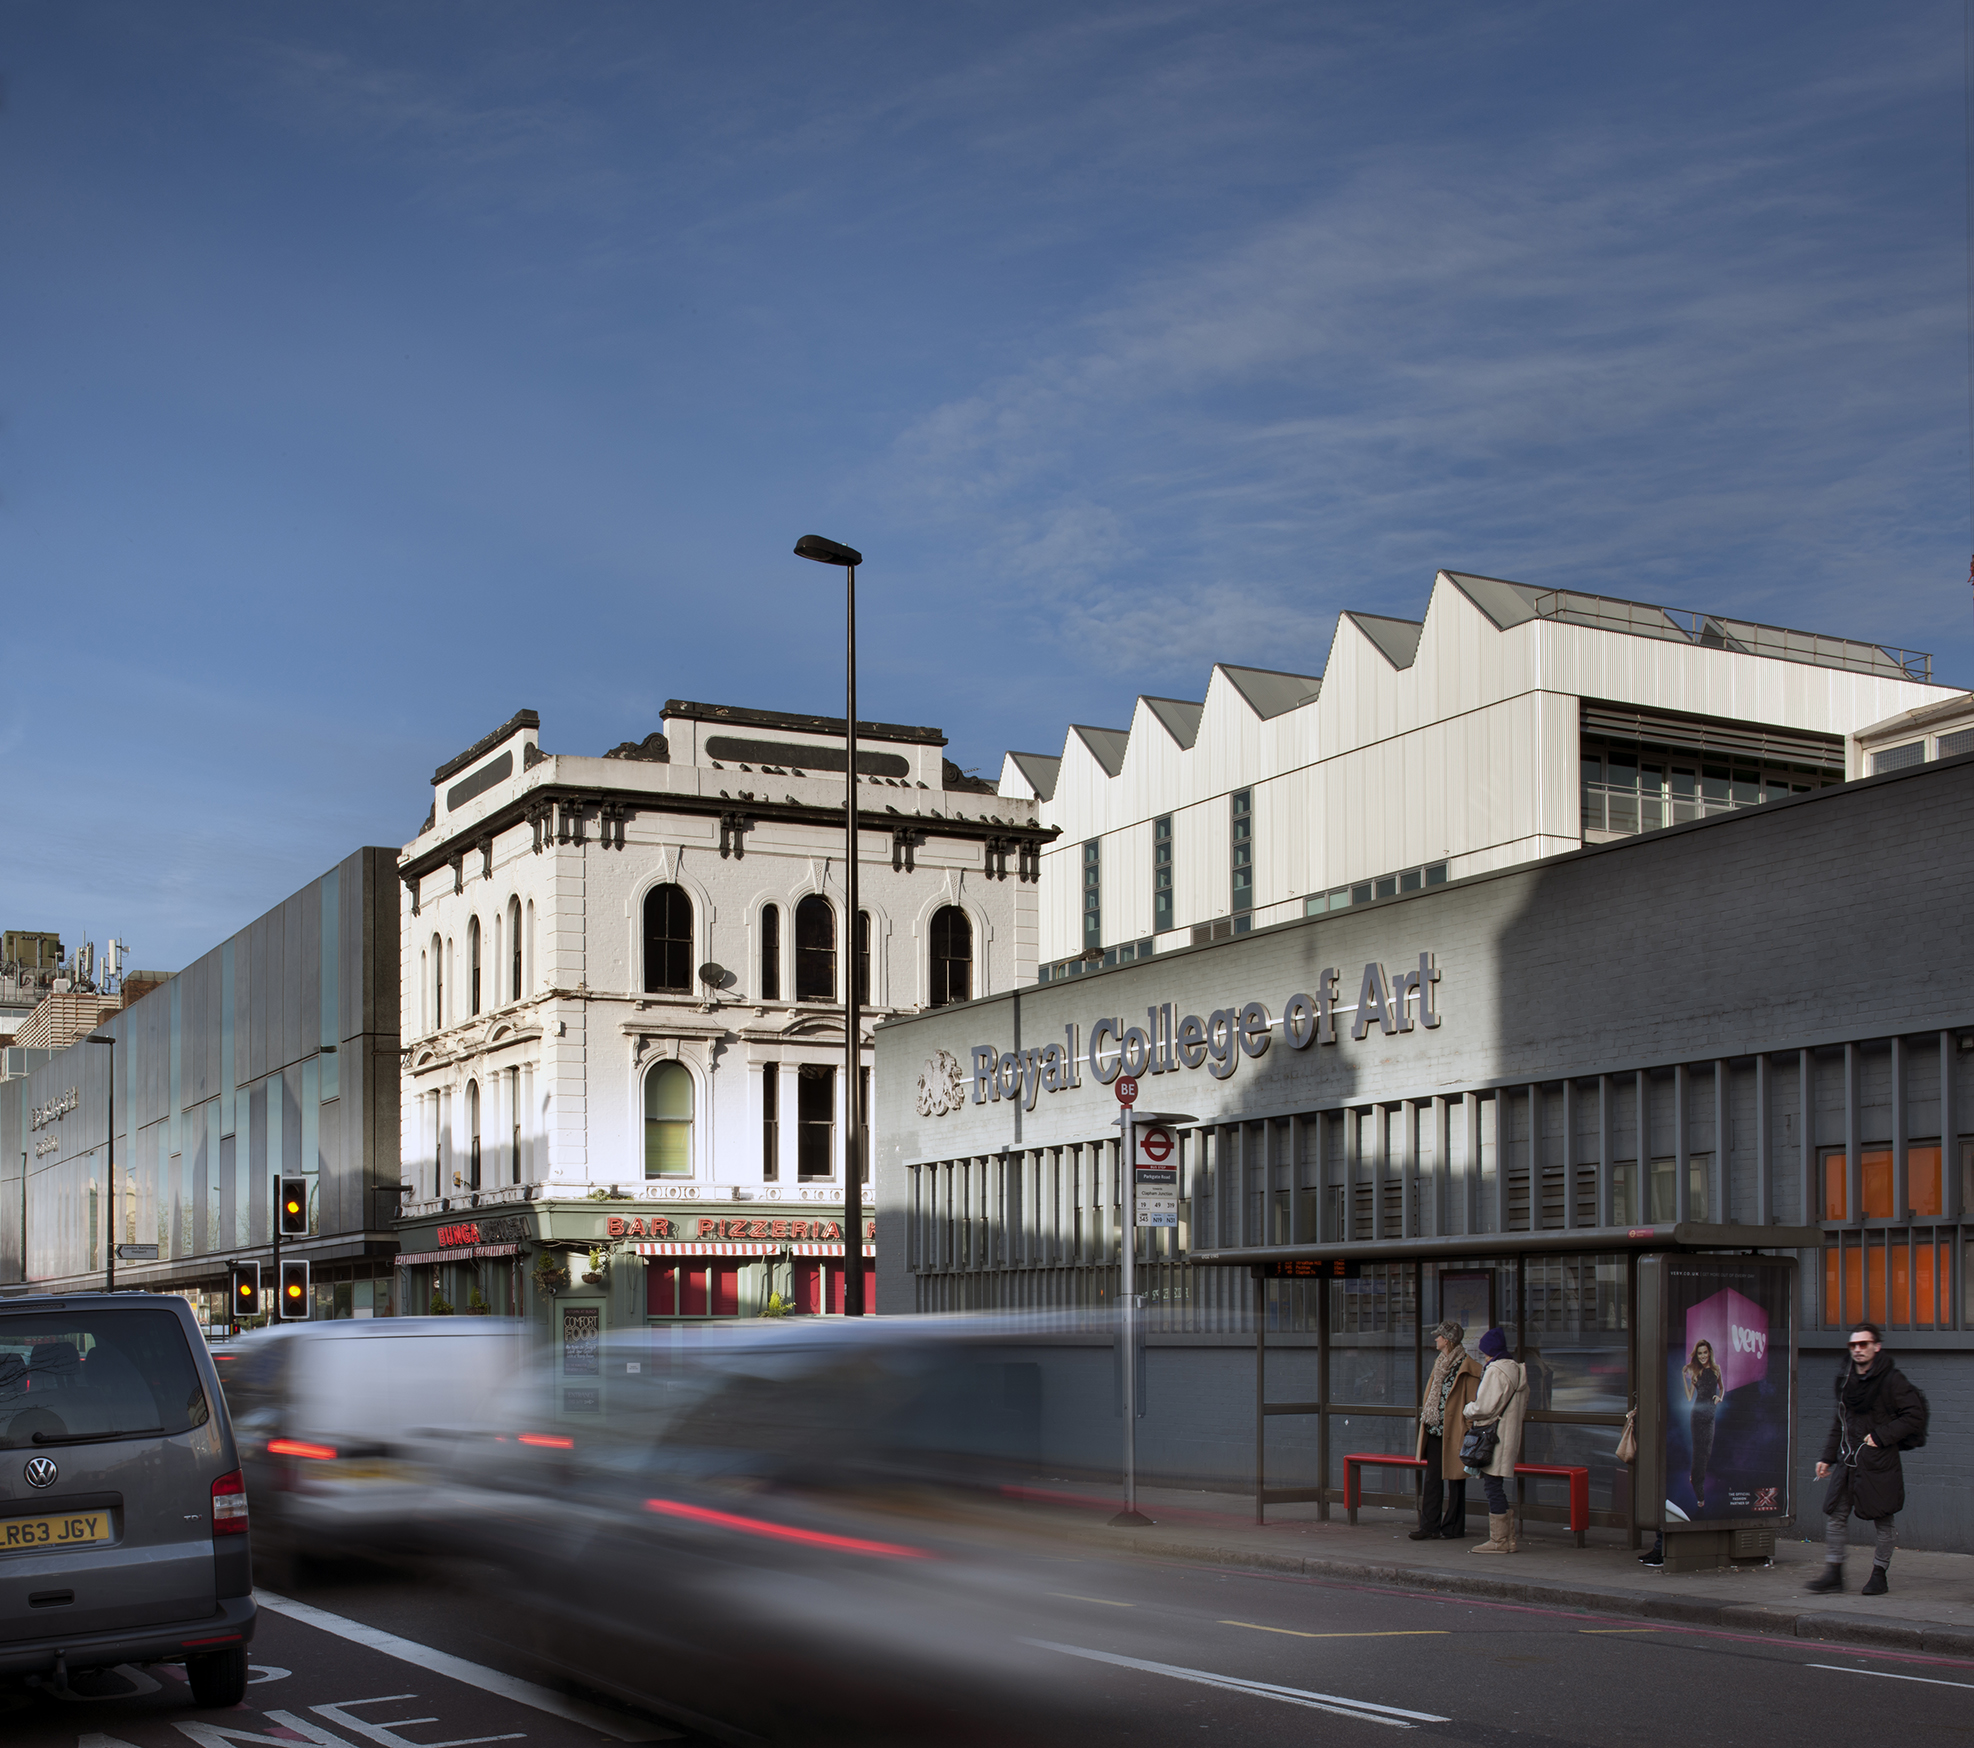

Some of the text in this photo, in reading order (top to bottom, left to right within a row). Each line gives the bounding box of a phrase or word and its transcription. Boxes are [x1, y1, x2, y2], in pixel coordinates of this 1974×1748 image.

[971, 952, 1440, 1111] Royal College of Art
[1121, 1083, 1135, 1096] BE
[437, 1222, 480, 1247] BUNGA
[606, 1217, 669, 1236] BAR
[697, 1218, 841, 1239] PIZZERIA
[564, 1315, 598, 1327] COMFORT
[564, 1326, 598, 1341] FOOD
[1731, 1324, 1766, 1360] very
[57, 1517, 98, 1540] JGY
